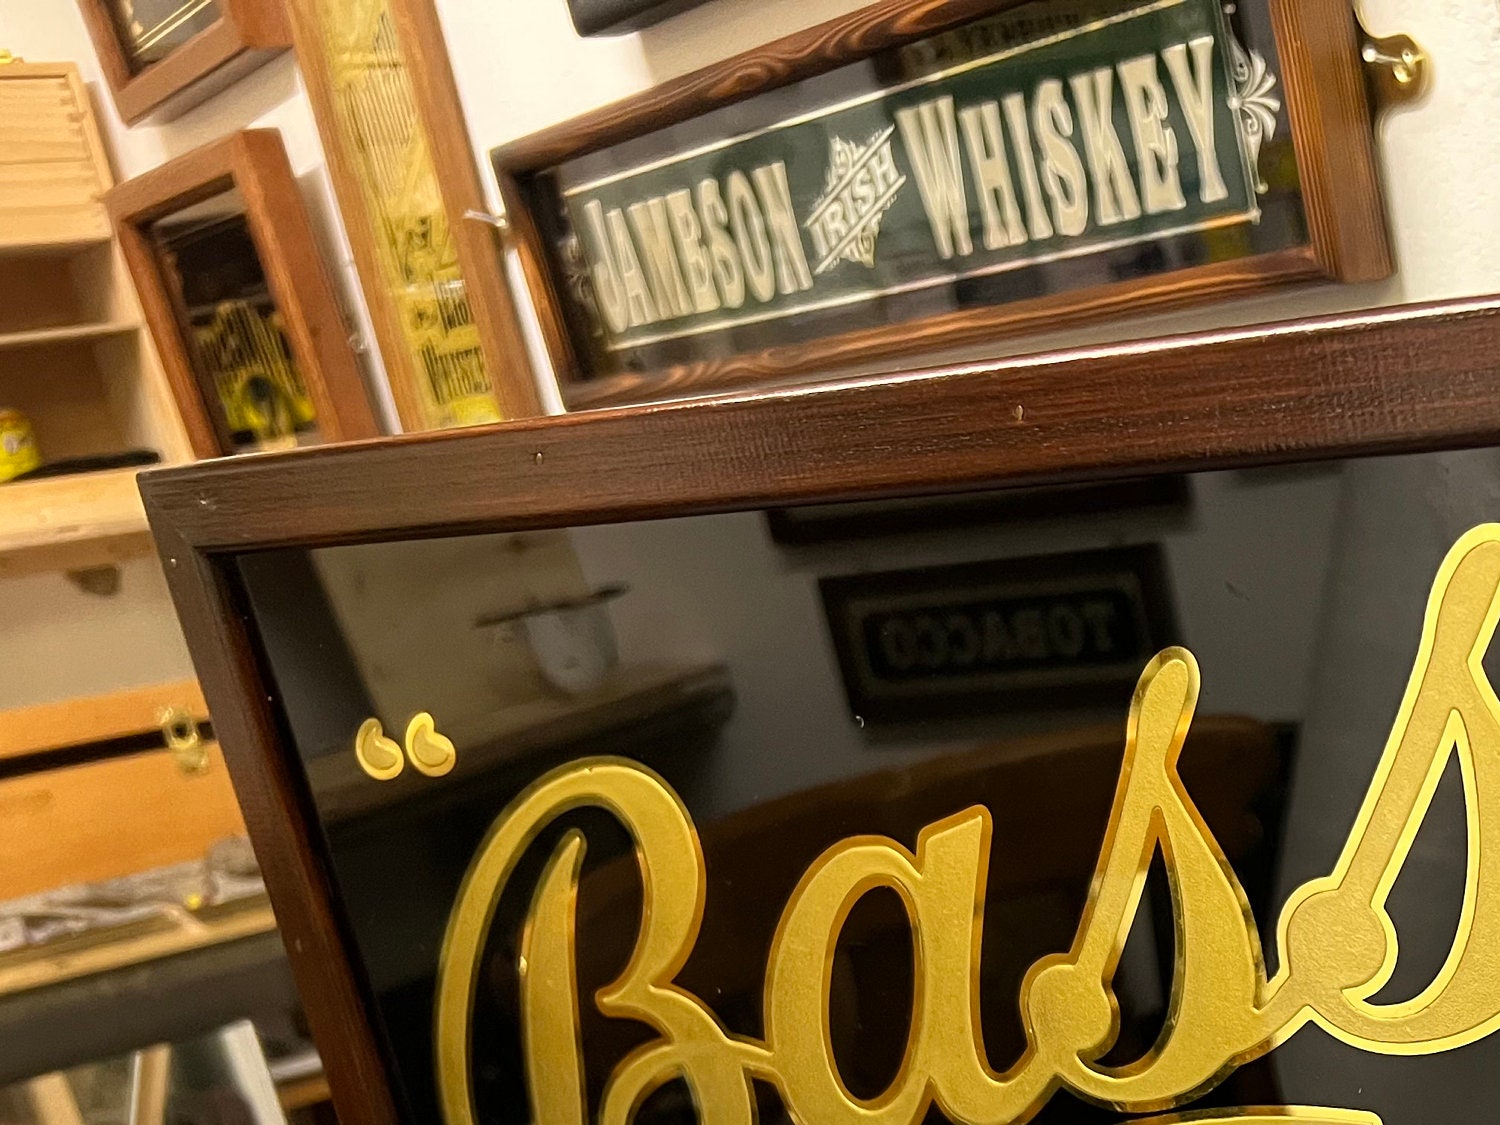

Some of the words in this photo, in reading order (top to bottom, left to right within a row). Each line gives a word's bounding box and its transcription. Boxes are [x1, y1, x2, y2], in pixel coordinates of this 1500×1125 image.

[583, 159, 814, 334] JAMESON
[809, 146, 899, 260] IRISH
[895, 34, 1229, 260] WHISKEY
